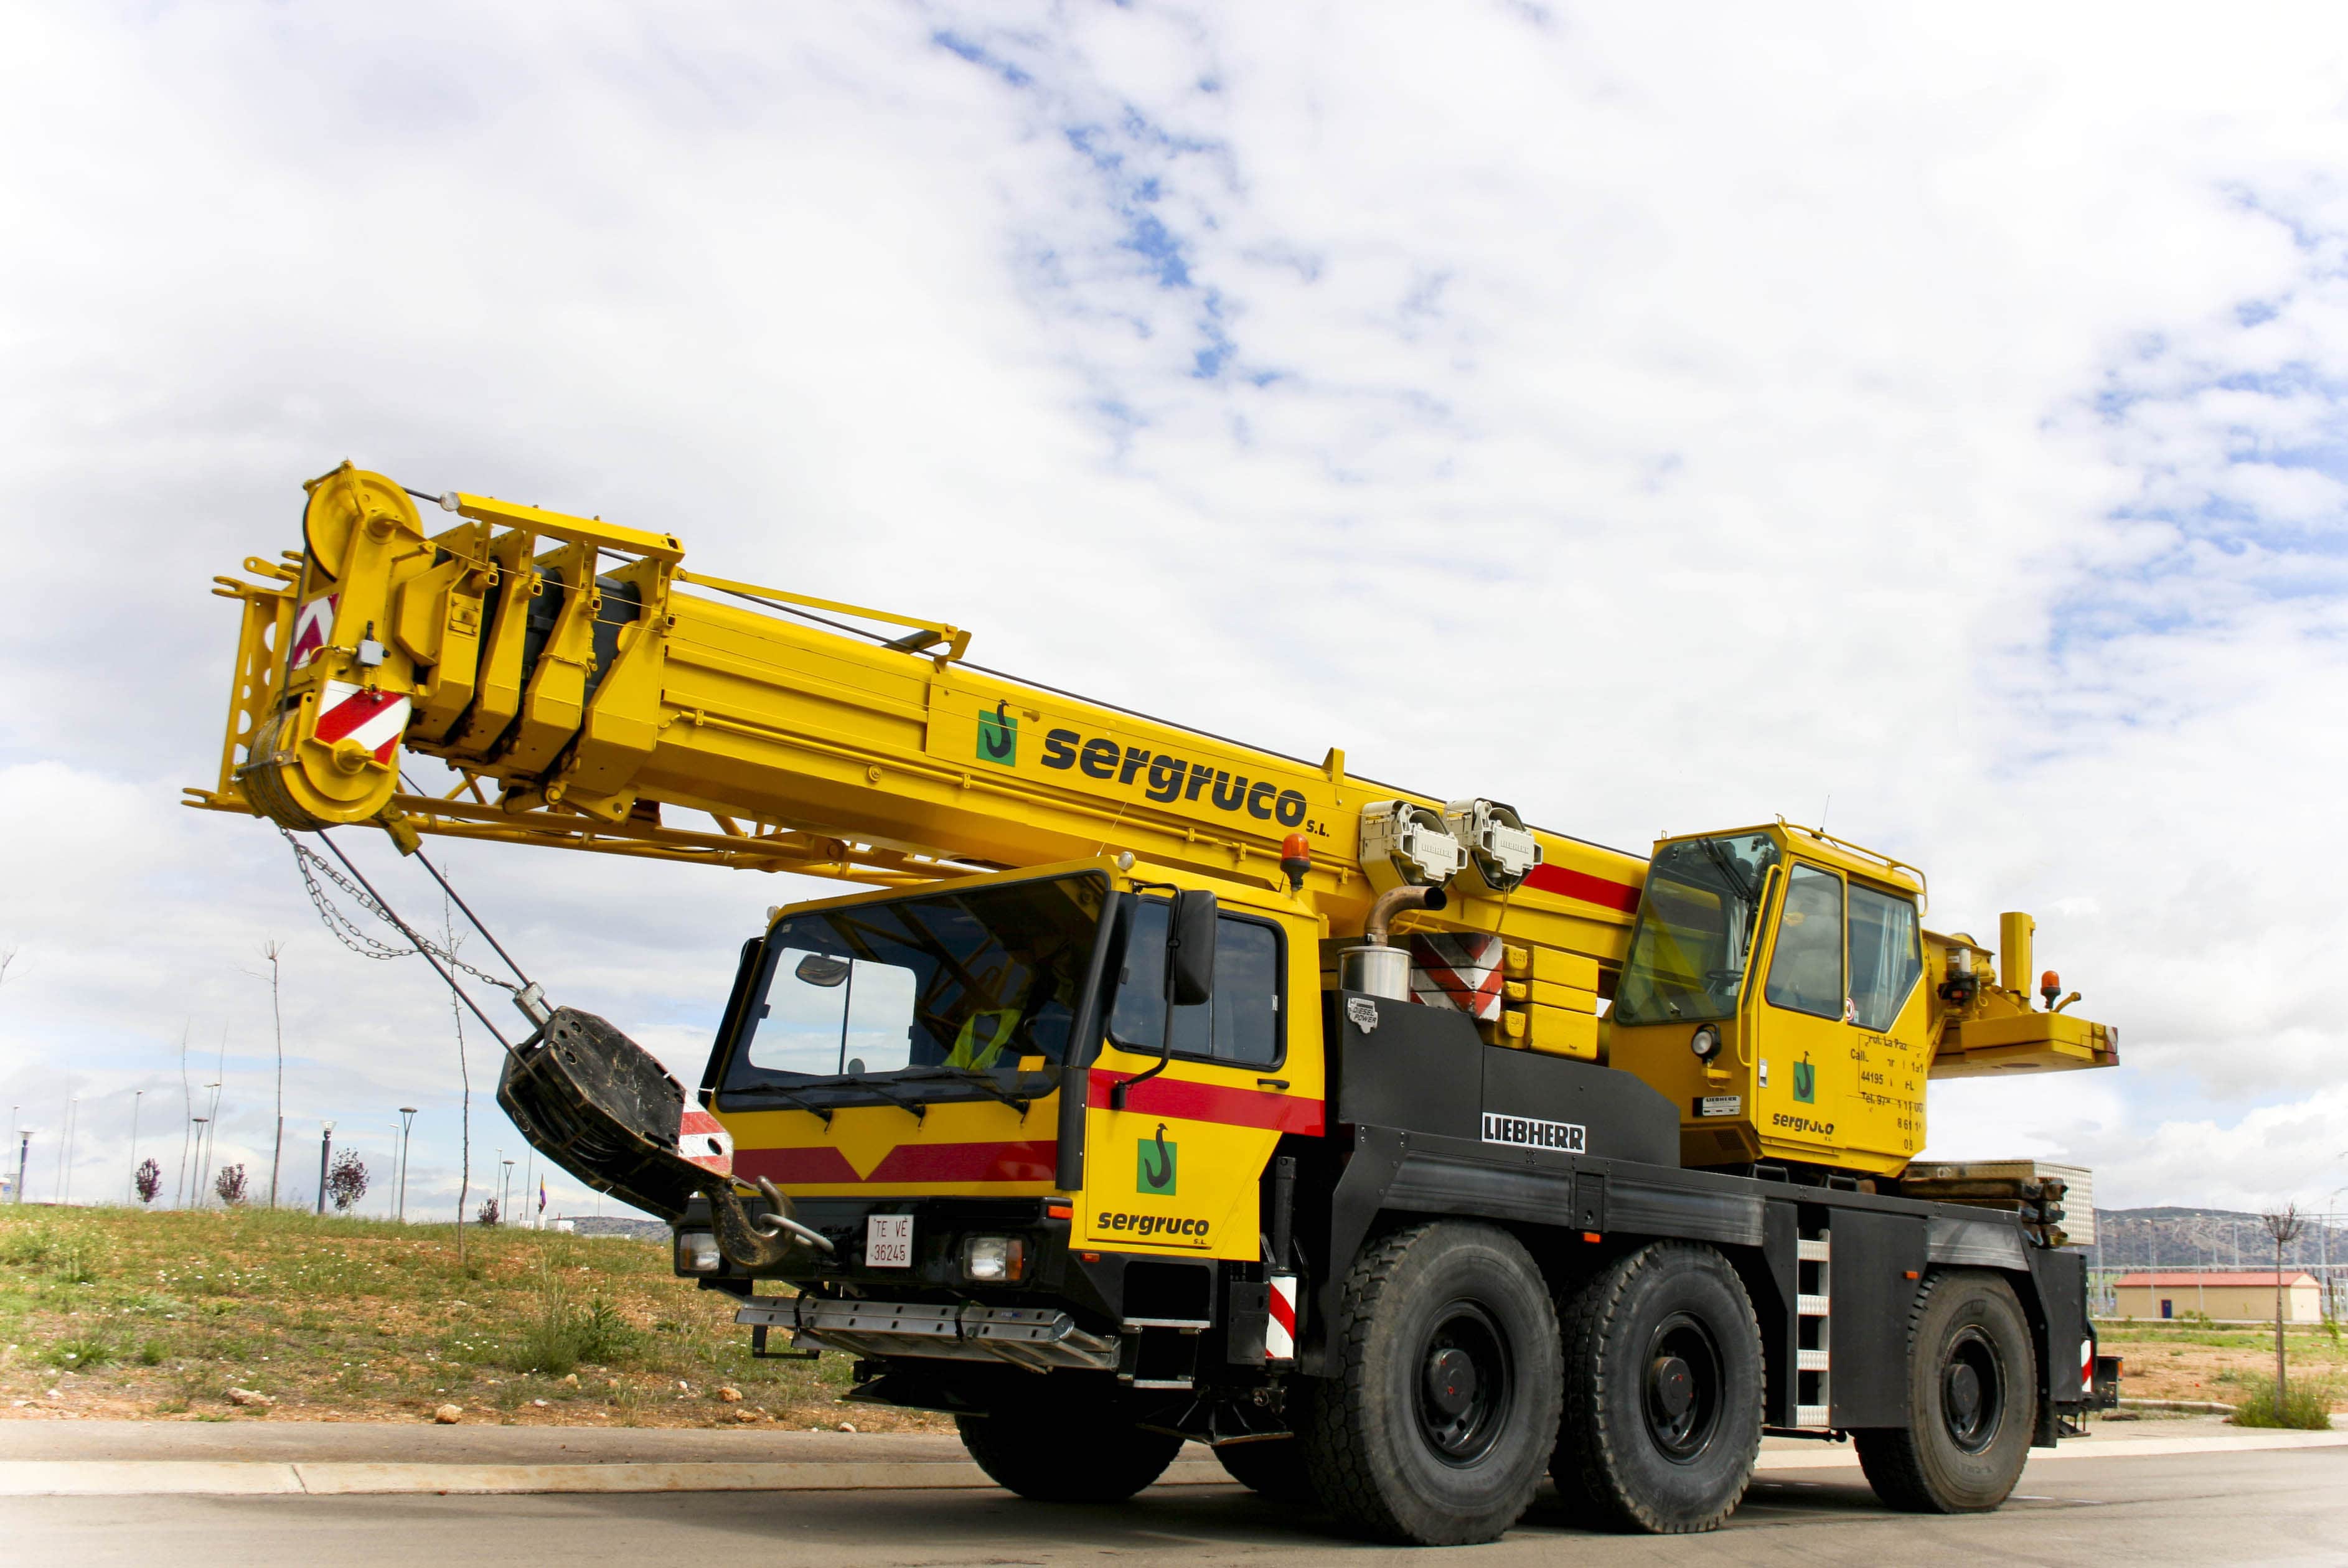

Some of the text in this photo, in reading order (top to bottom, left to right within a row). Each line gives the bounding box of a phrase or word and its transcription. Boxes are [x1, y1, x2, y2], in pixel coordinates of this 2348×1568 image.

[1041, 728, 1330, 837] sergruco S.L.
[1353, 1007, 1374, 1016] DIESEL
[1354, 1014, 1377, 1023] POWER
[1850, 1048, 1869, 1062] Call
[1861, 1071, 1884, 1085] 44195
[1484, 1115, 1583, 1151] LIEBHERR
[876, 1220, 908, 1238] TE VE
[1097, 1211, 1210, 1237] sergruco
[874, 1244, 906, 1261] 36245
